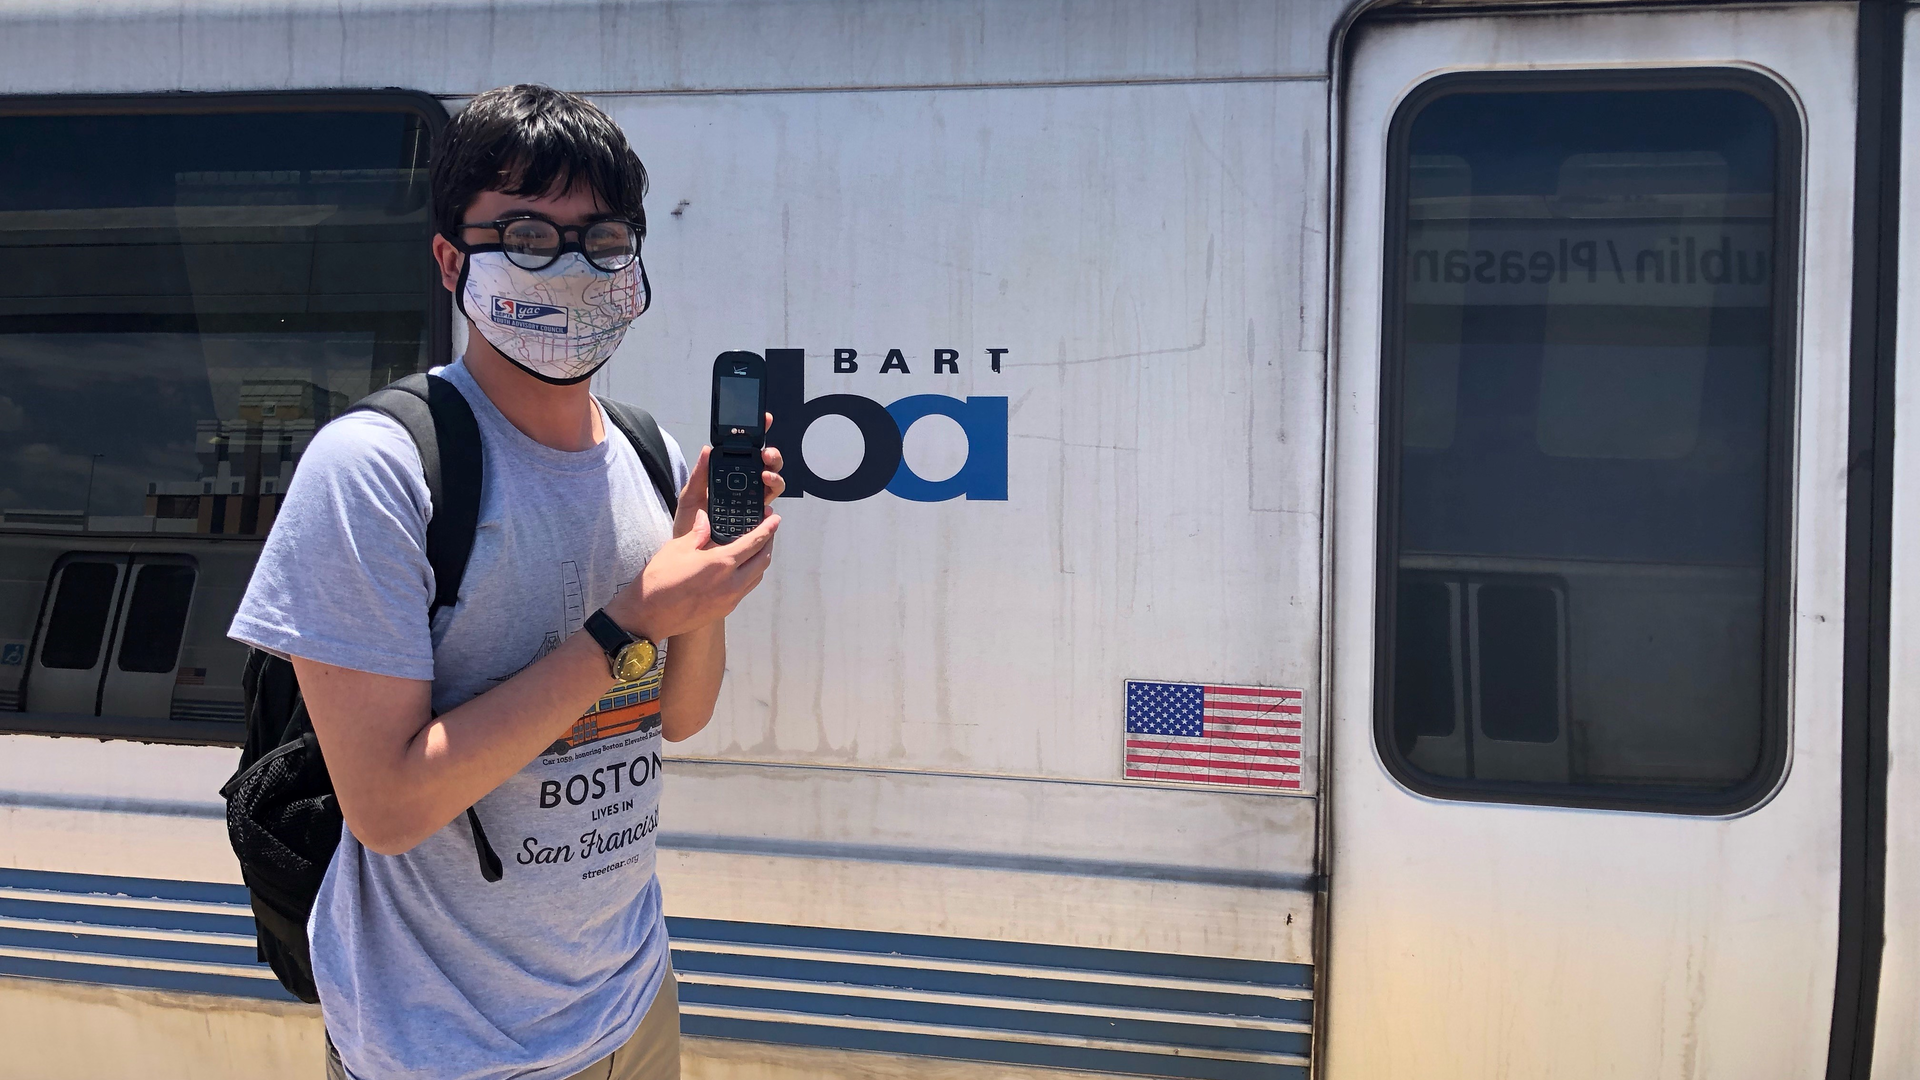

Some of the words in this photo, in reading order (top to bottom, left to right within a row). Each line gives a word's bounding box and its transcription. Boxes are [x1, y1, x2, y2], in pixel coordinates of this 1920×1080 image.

[493, 317, 511, 325] YOUTH
[511, 320, 540, 330] ADVISORY
[540, 325, 564, 333] COUNCIL
[494, 311, 514, 319] SEPTA
[517, 307, 541, 319] yac
[833, 348, 1009, 374] BART
[765, 348, 1009, 502] ba
[542, 758, 555, 766] Car
[557, 756, 574, 764] 1059,
[574, 747, 602, 760] honoring
[602, 742, 624, 752] Boston
[624, 733, 648, 746] Elevated
[539, 751, 662, 809] BOSTON
[591, 803, 619, 821] LIVES
[622, 799, 634, 811] IN
[516, 836, 575, 865] San
[580, 804, 659, 859] Francisc
[582, 854, 639, 880] streetcar.org
